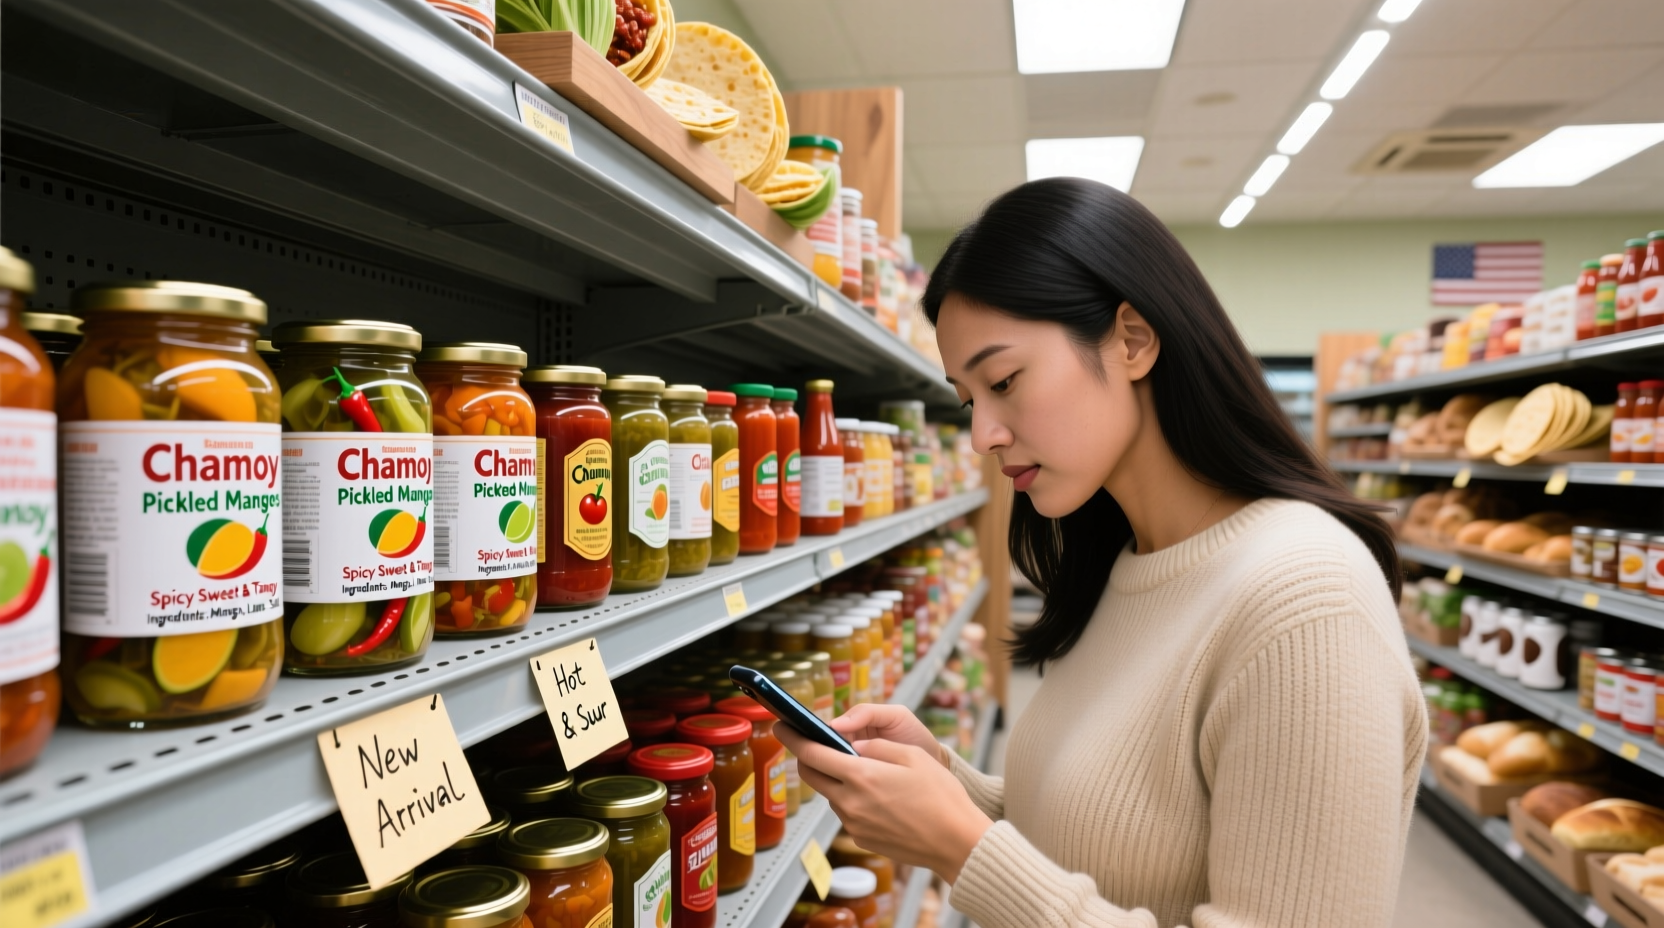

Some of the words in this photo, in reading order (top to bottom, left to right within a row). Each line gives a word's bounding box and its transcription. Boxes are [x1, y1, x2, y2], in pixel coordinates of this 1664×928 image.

[142, 443, 279, 488] Chamoy
[143, 491, 219, 513] Pickled
[338, 485, 394, 505] Pickled
[477, 549, 504, 564] Spicy
[343, 566, 376, 581] Spicy
[150, 589, 194, 609] Spicy
[198, 586, 239, 602] Sweet
[553, 662, 586, 697] Hot
[561, 711, 578, 739] &
[358, 734, 418, 789] New
[377, 761, 466, 848] Arrival
